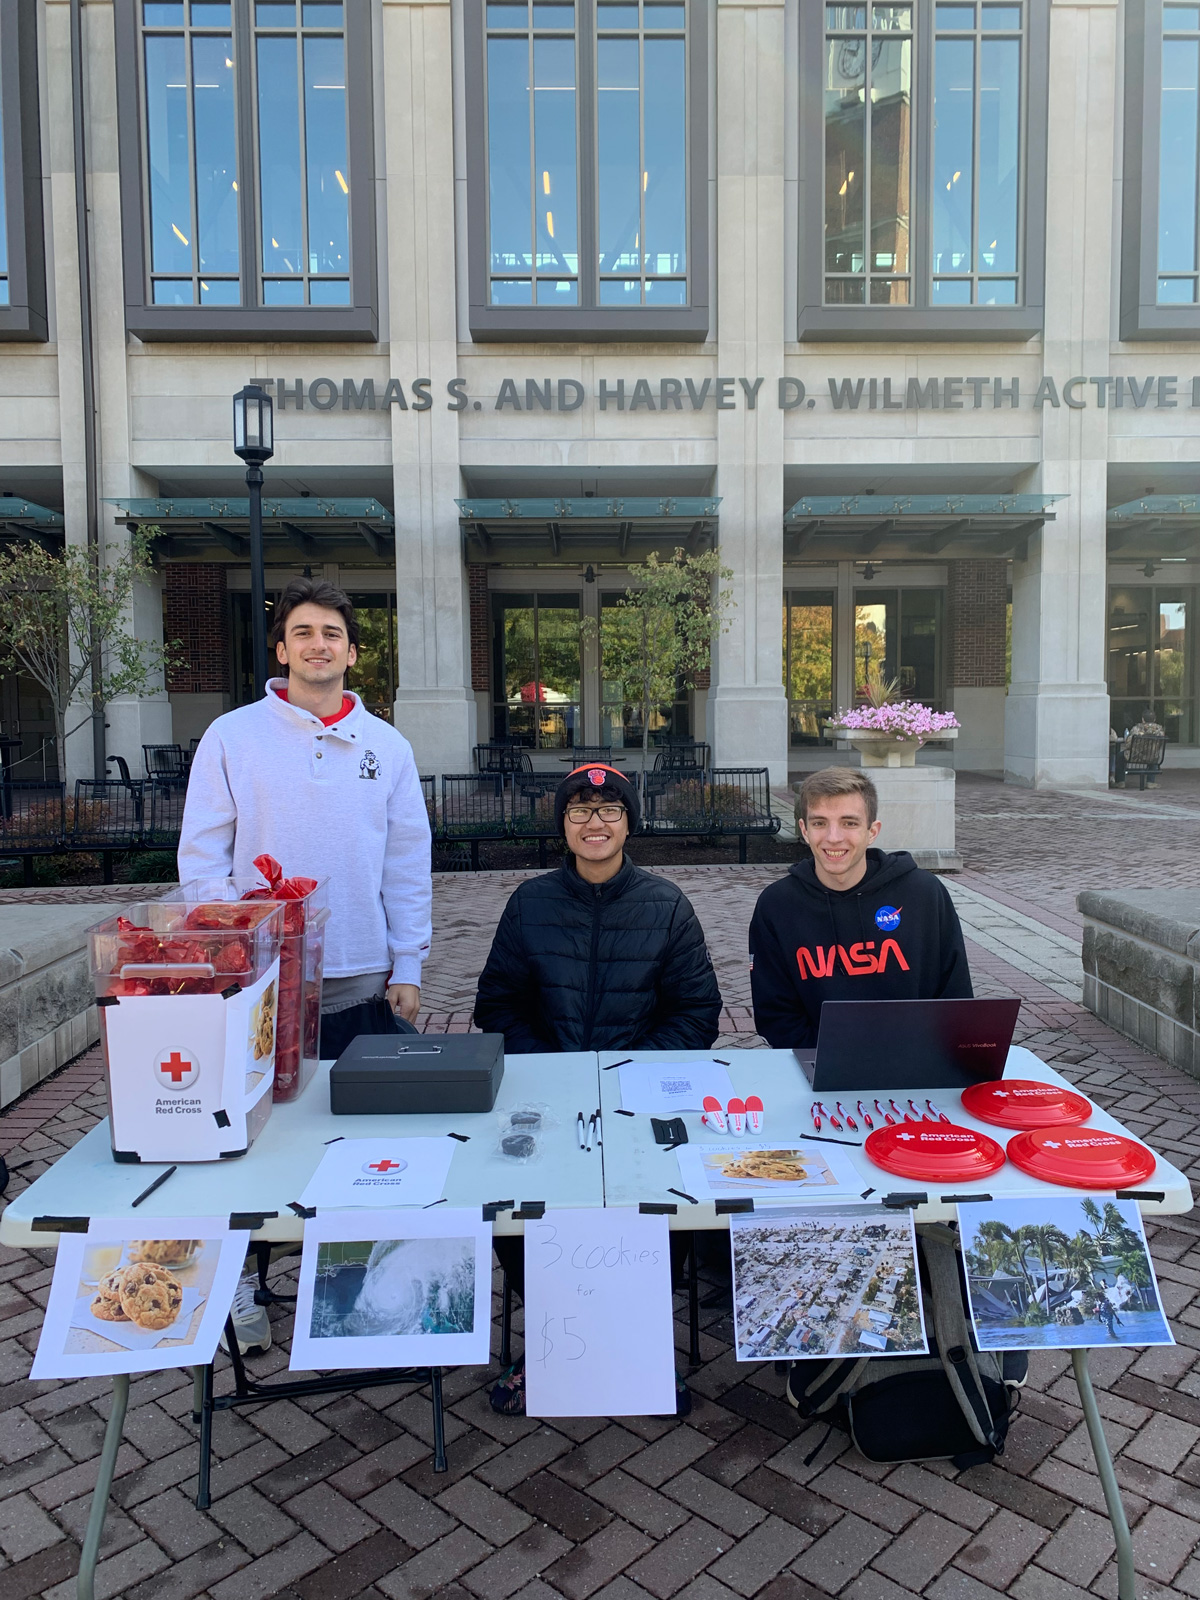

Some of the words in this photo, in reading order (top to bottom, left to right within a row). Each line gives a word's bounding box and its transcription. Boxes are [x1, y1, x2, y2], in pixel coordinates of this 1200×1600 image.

[250, 378, 433, 411] THOMAS
[447, 378, 481, 411] S.
[494, 378, 585, 411] AND
[599, 377, 764, 411] HARVEY
[778, 377, 816, 410] D.
[827, 377, 1020, 410] WILMETH
[1033, 376, 1178, 409] ACTIVE
[876, 914, 900, 922] NASA
[796, 938, 910, 980] NASA
[155, 1098, 202, 1106] American
[155, 1106, 174, 1114] Red
[175, 1106, 202, 1114] Cross
[1064, 1137, 1118, 1145] American
[536, 1224, 563, 1269] 3
[577, 1284, 595, 1297] for
[536, 1311, 587, 1369] $5
